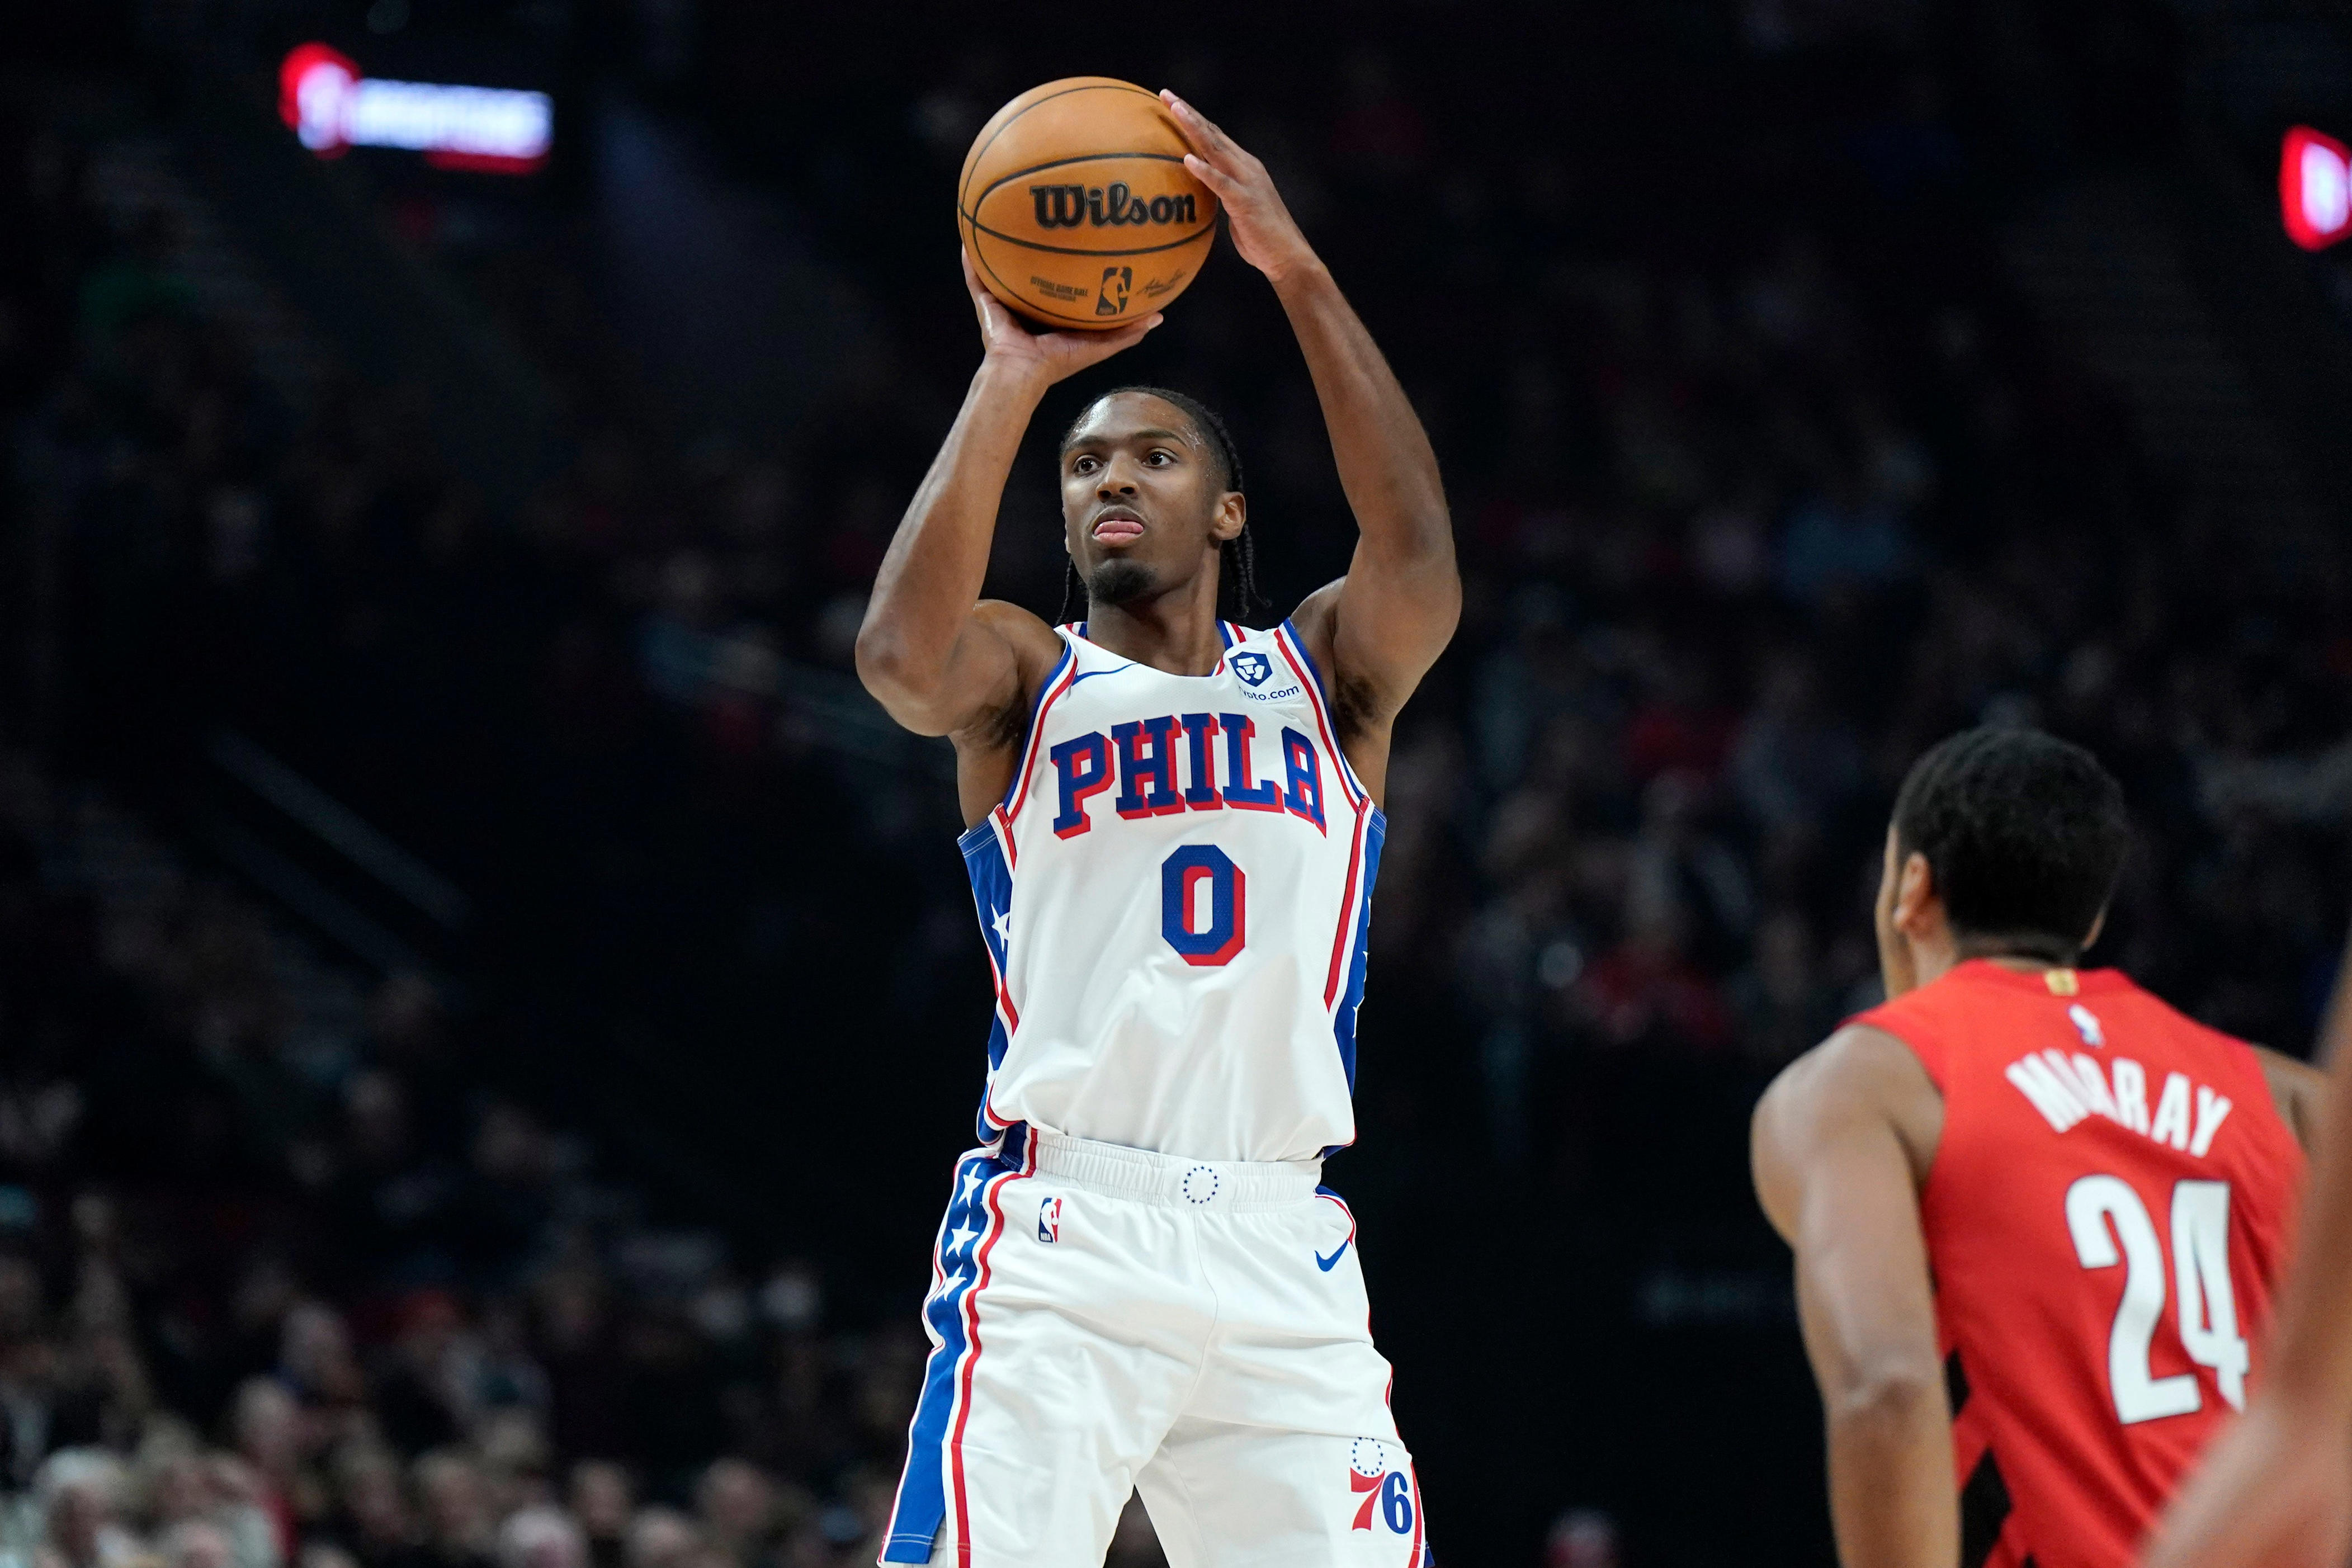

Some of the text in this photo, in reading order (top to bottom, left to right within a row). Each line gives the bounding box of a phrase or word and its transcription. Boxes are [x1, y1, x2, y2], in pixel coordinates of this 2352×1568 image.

[1030, 182, 1196, 228] Wilson
[1238, 684, 1300, 701] rypto.com
[1050, 713, 1326, 840] PHILA
[1161, 844, 1246, 966] 0
[1041, 1232, 1051, 1241] NBA
[2064, 1174, 2250, 1425] 24
[1350, 1467, 1413, 1534] 76
